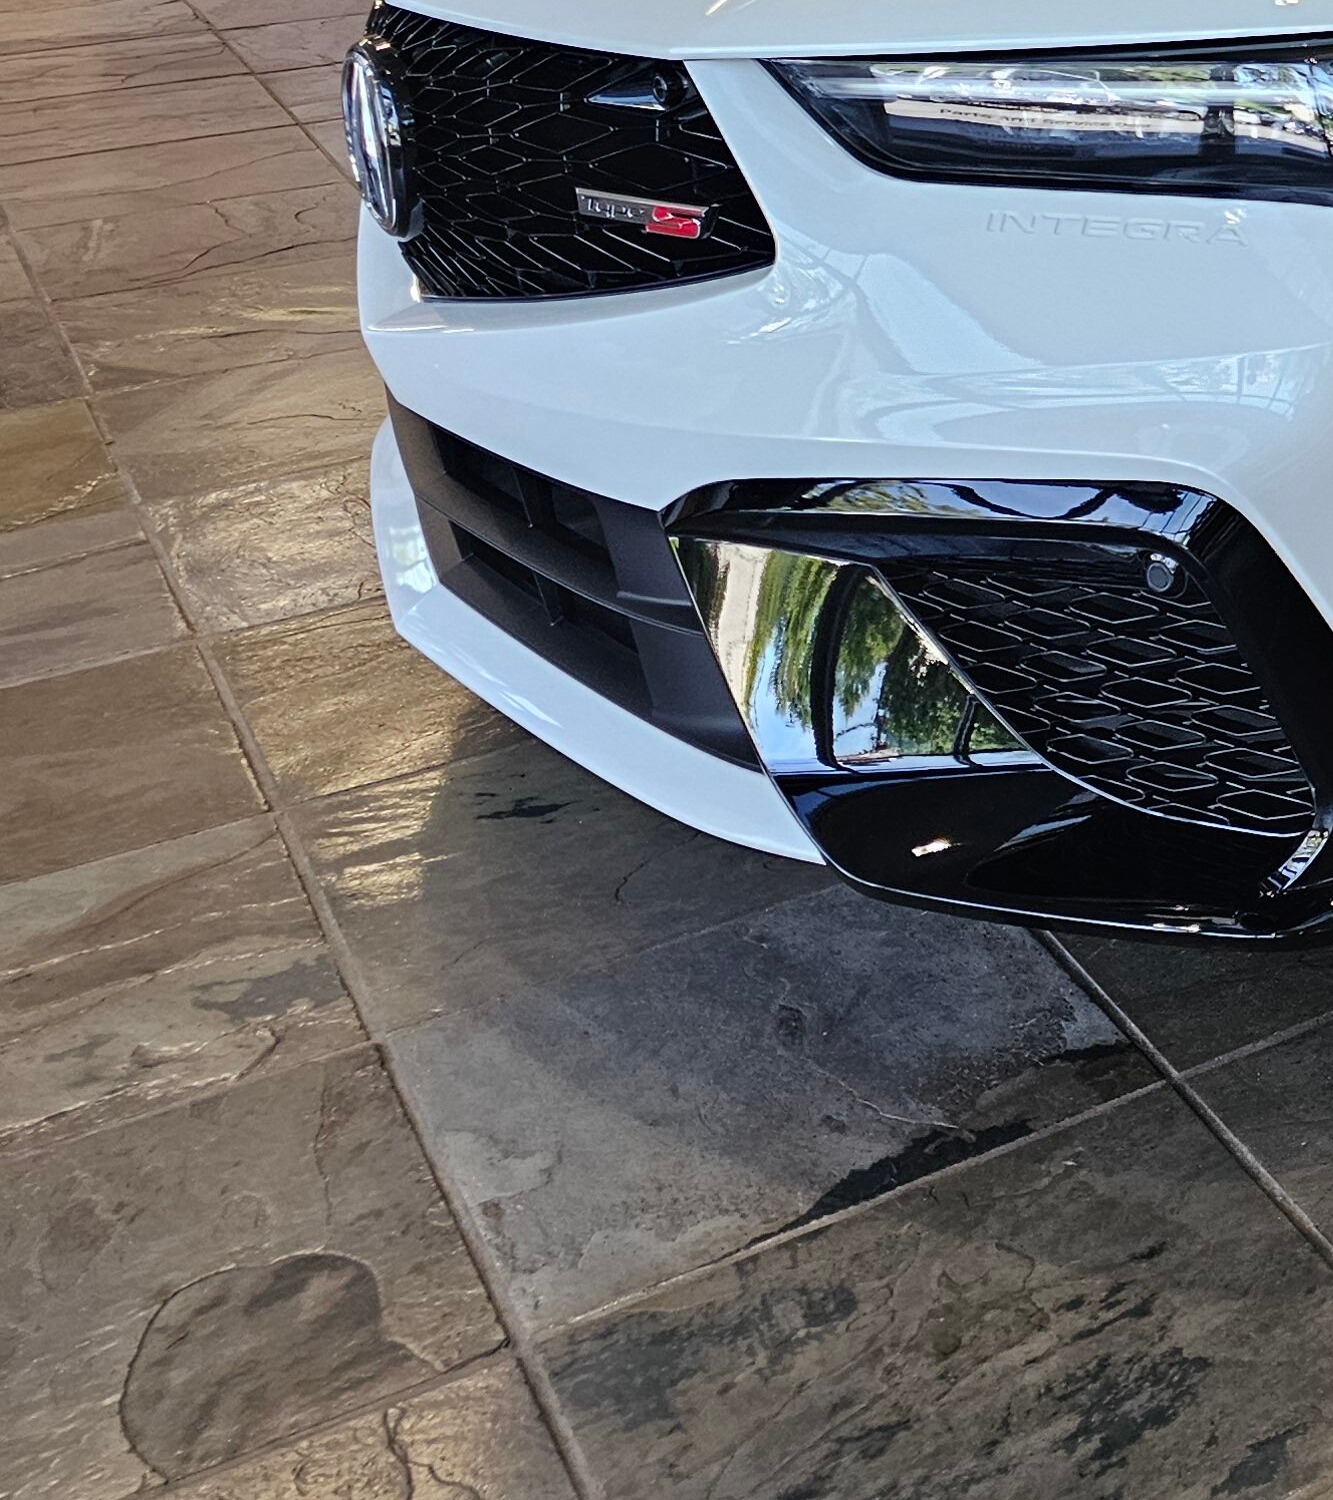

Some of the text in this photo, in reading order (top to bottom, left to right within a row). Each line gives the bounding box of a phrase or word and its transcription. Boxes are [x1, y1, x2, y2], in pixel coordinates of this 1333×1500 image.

[939, 108, 993, 119] Parts
[646, 206, 706, 239] S
[986, 209, 1248, 247] INTEGRA
